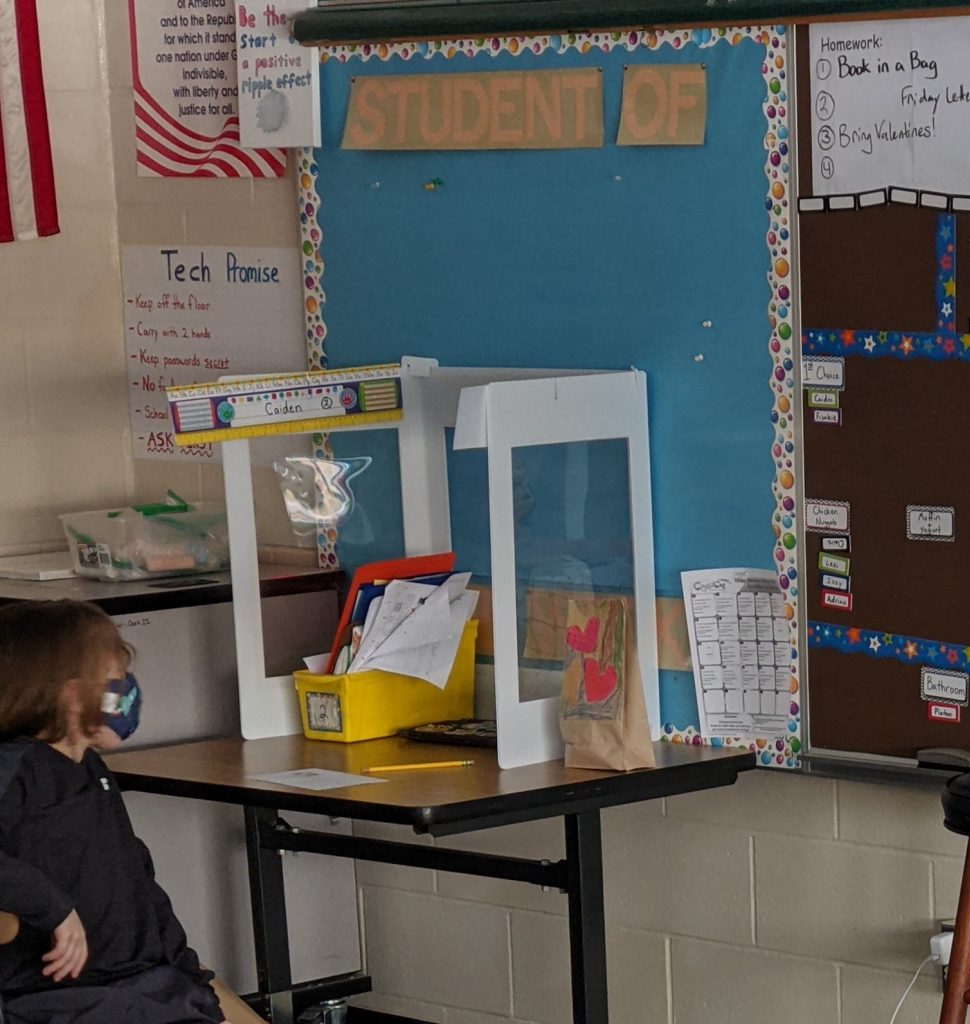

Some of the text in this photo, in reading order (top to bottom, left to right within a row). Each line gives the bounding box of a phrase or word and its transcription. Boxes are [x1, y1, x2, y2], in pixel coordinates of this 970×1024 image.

[160, 12, 235, 27] and to the Repub
[239, 5, 287, 28] Be the
[164, 32, 236, 45] for which it stand
[240, 34, 277, 49] Start
[821, 34, 884, 52] Homework:
[156, 54, 172, 63] one
[175, 50, 202, 62] nation
[204, 49, 229, 61] under
[838, 55, 871, 78] Book
[878, 58, 889, 73] in
[895, 63, 905, 72] a
[910, 50, 938, 79] Bag
[182, 67, 228, 80] indivisible,
[242, 58, 249, 70] a
[255, 54, 301, 76] positive
[173, 84, 238, 100] with liberty and
[242, 71, 312, 98] ripple effect
[350, 68, 705, 145] STUDENT OF
[901, 85, 940, 114] Friday
[178, 103, 235, 117] justice for all.
[839, 123, 872, 154] Bring
[874, 116, 936, 142] Valentines!
[161, 250, 280, 283] Tech Promise
[135, 294, 210, 312] Keep off the floor
[137, 322, 211, 344] Carry with 2 hands
[139, 350, 230, 372] Keep passwords secret
[817, 366, 840, 380] Choice
[142, 375, 156, 392] No
[145, 406, 168, 420] School
[265, 402, 302, 416] Caiden
[148, 431, 174, 448] ASK
[813, 506, 838, 516] Chicken
[926, 676, 964, 695] Bathroom
[320, 704, 328, 719] 2
